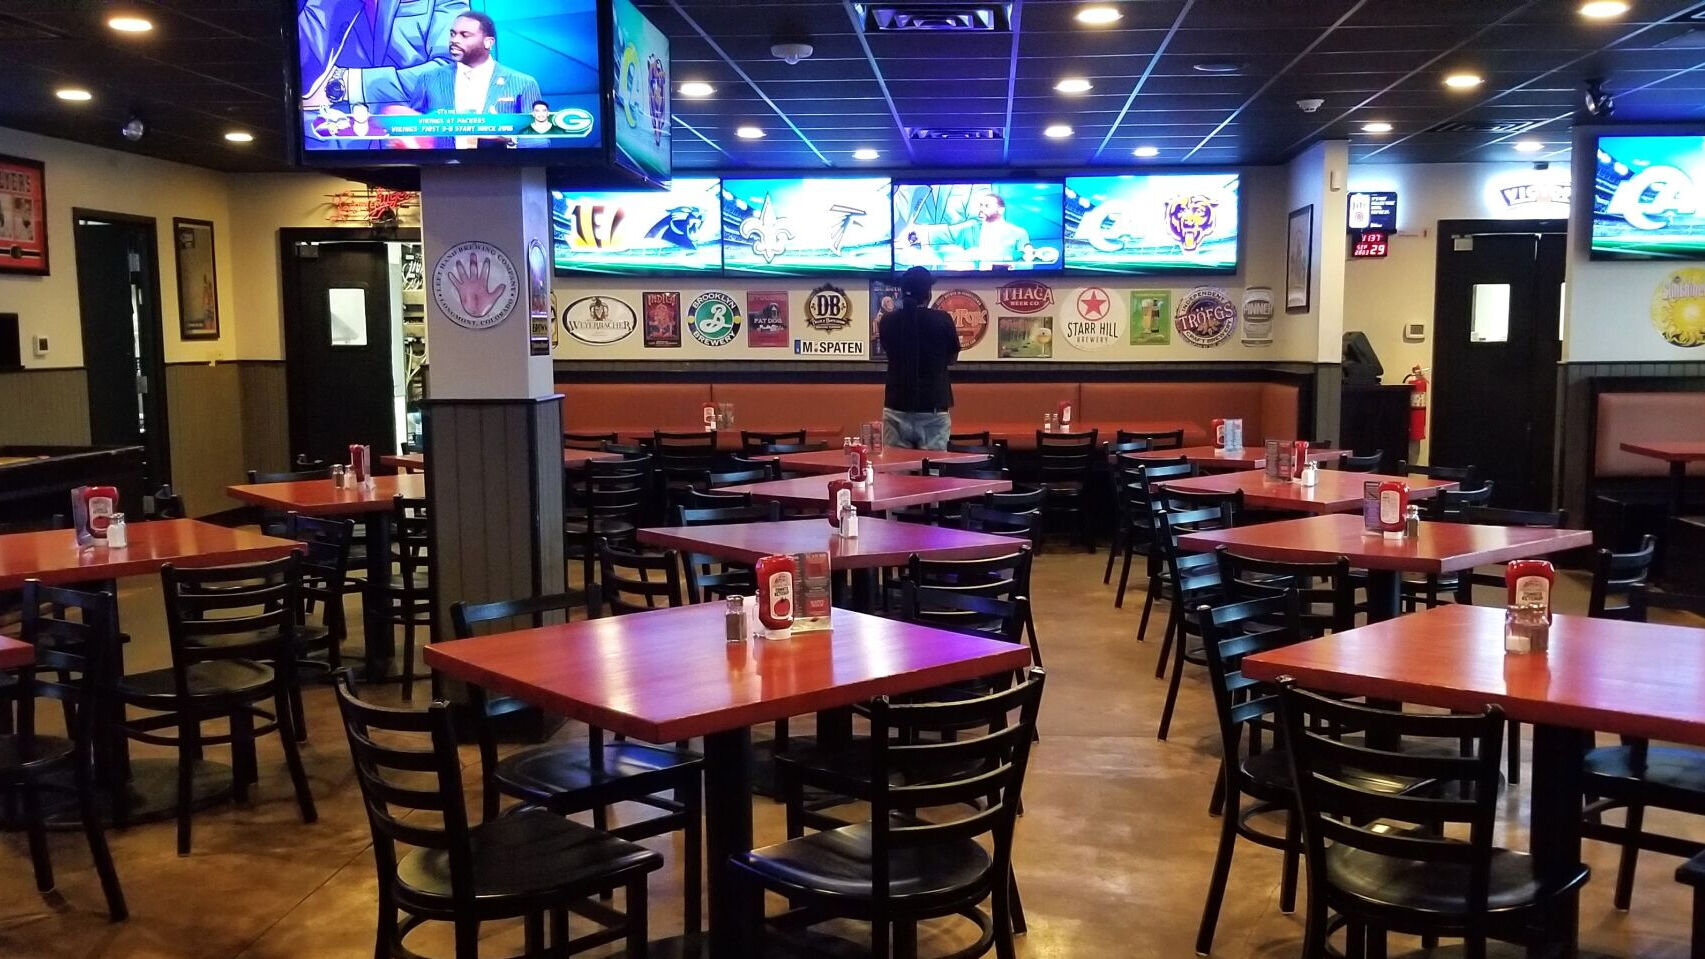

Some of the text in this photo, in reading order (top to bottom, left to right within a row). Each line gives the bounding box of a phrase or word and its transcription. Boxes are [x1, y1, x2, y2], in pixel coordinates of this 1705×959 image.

[1370, 244, 1386, 255] 29
[440, 249, 458, 270] HAND
[458, 243, 497, 256] BREWING
[497, 253, 518, 293] COMPANY
[647, 293, 676, 305] INDICA
[692, 292, 737, 309] BROOKLYN
[996, 286, 1055, 305] ITHACA
[1182, 291, 1225, 312] INDEPENDENT
[480, 297, 515, 326] COLORADO
[816, 294, 841, 317] DB
[568, 320, 632, 332] WEYERBACHER
[1067, 322, 1118, 338] STARR HILL
[1185, 320, 1232, 344] CRAFT BREWERY
[692, 331, 737, 347] BREWERY
[819, 341, 863, 354] SPATEN
